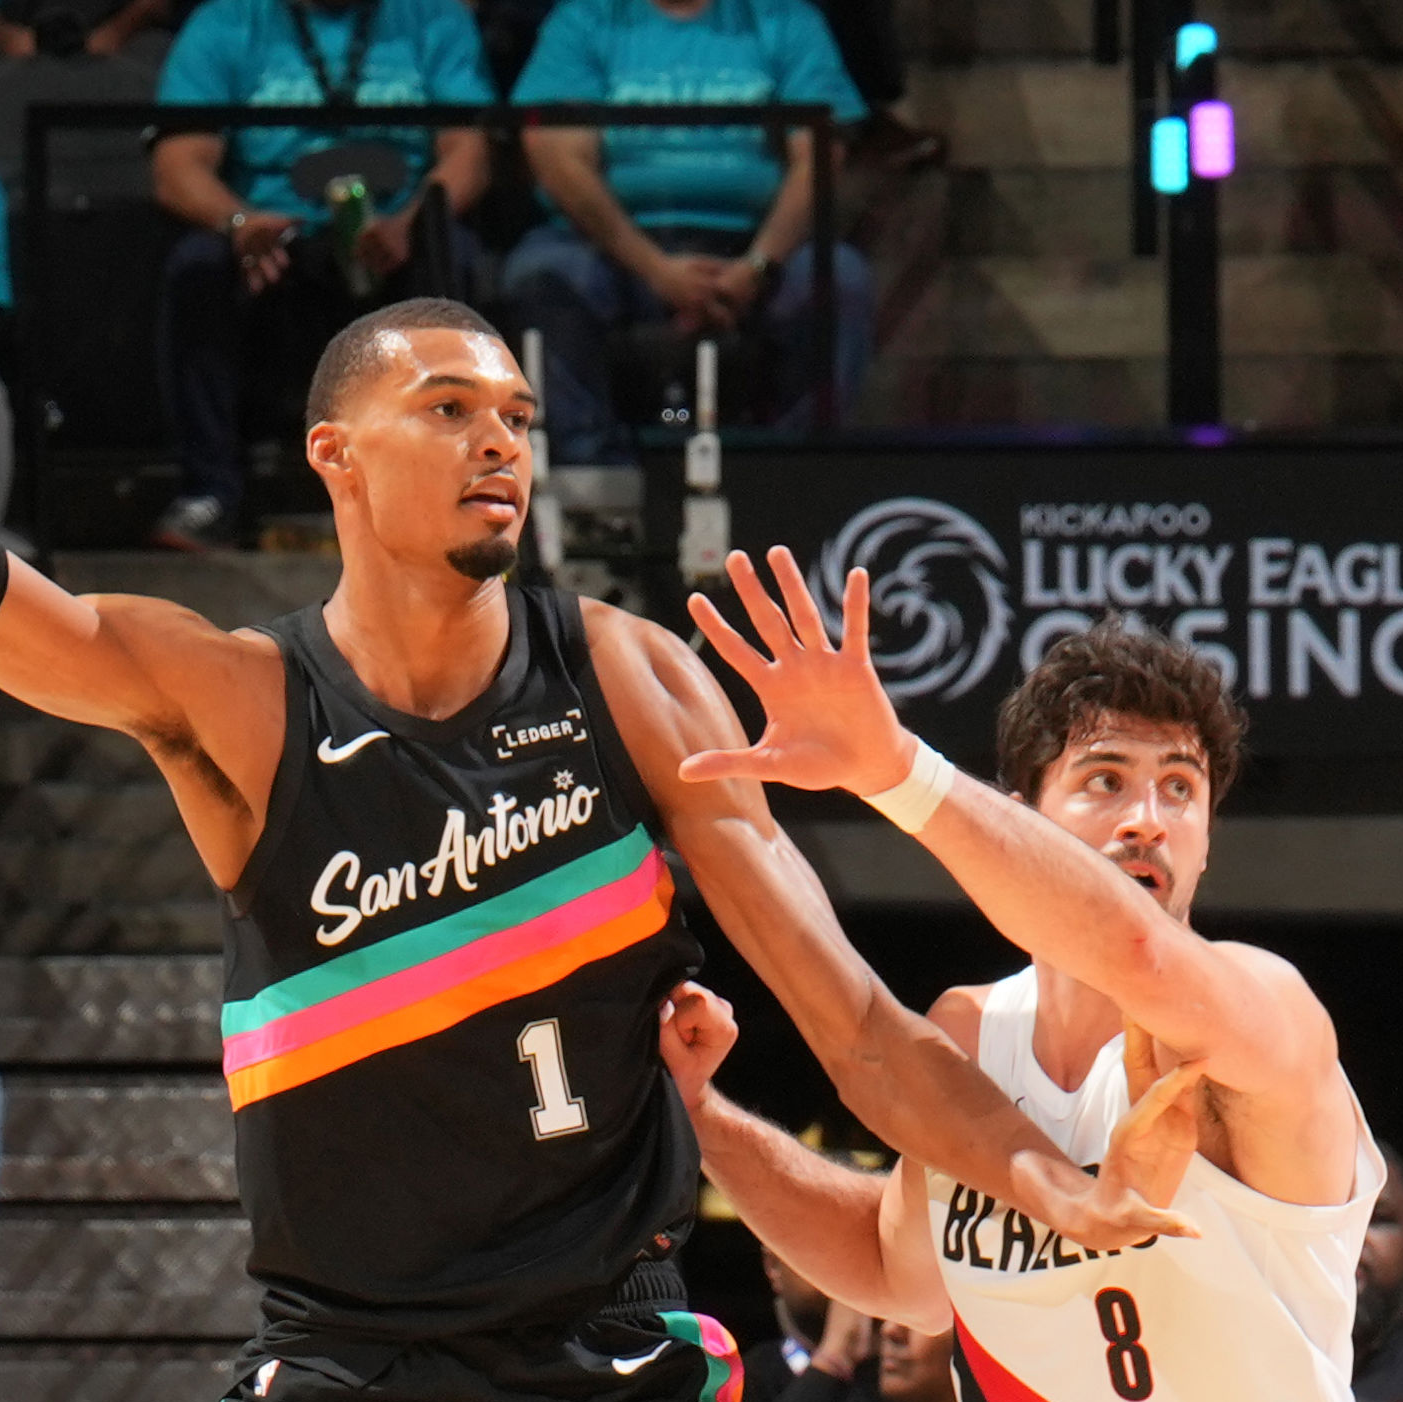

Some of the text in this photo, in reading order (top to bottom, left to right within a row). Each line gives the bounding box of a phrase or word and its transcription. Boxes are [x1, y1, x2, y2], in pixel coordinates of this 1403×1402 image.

[1022, 538, 1233, 606] LUCKY
[506, 719, 574, 748] LEDGER
[310, 768, 601, 946] San Antonio
[517, 1017, 589, 1142] 1
[1094, 1286, 1153, 1402] 8
